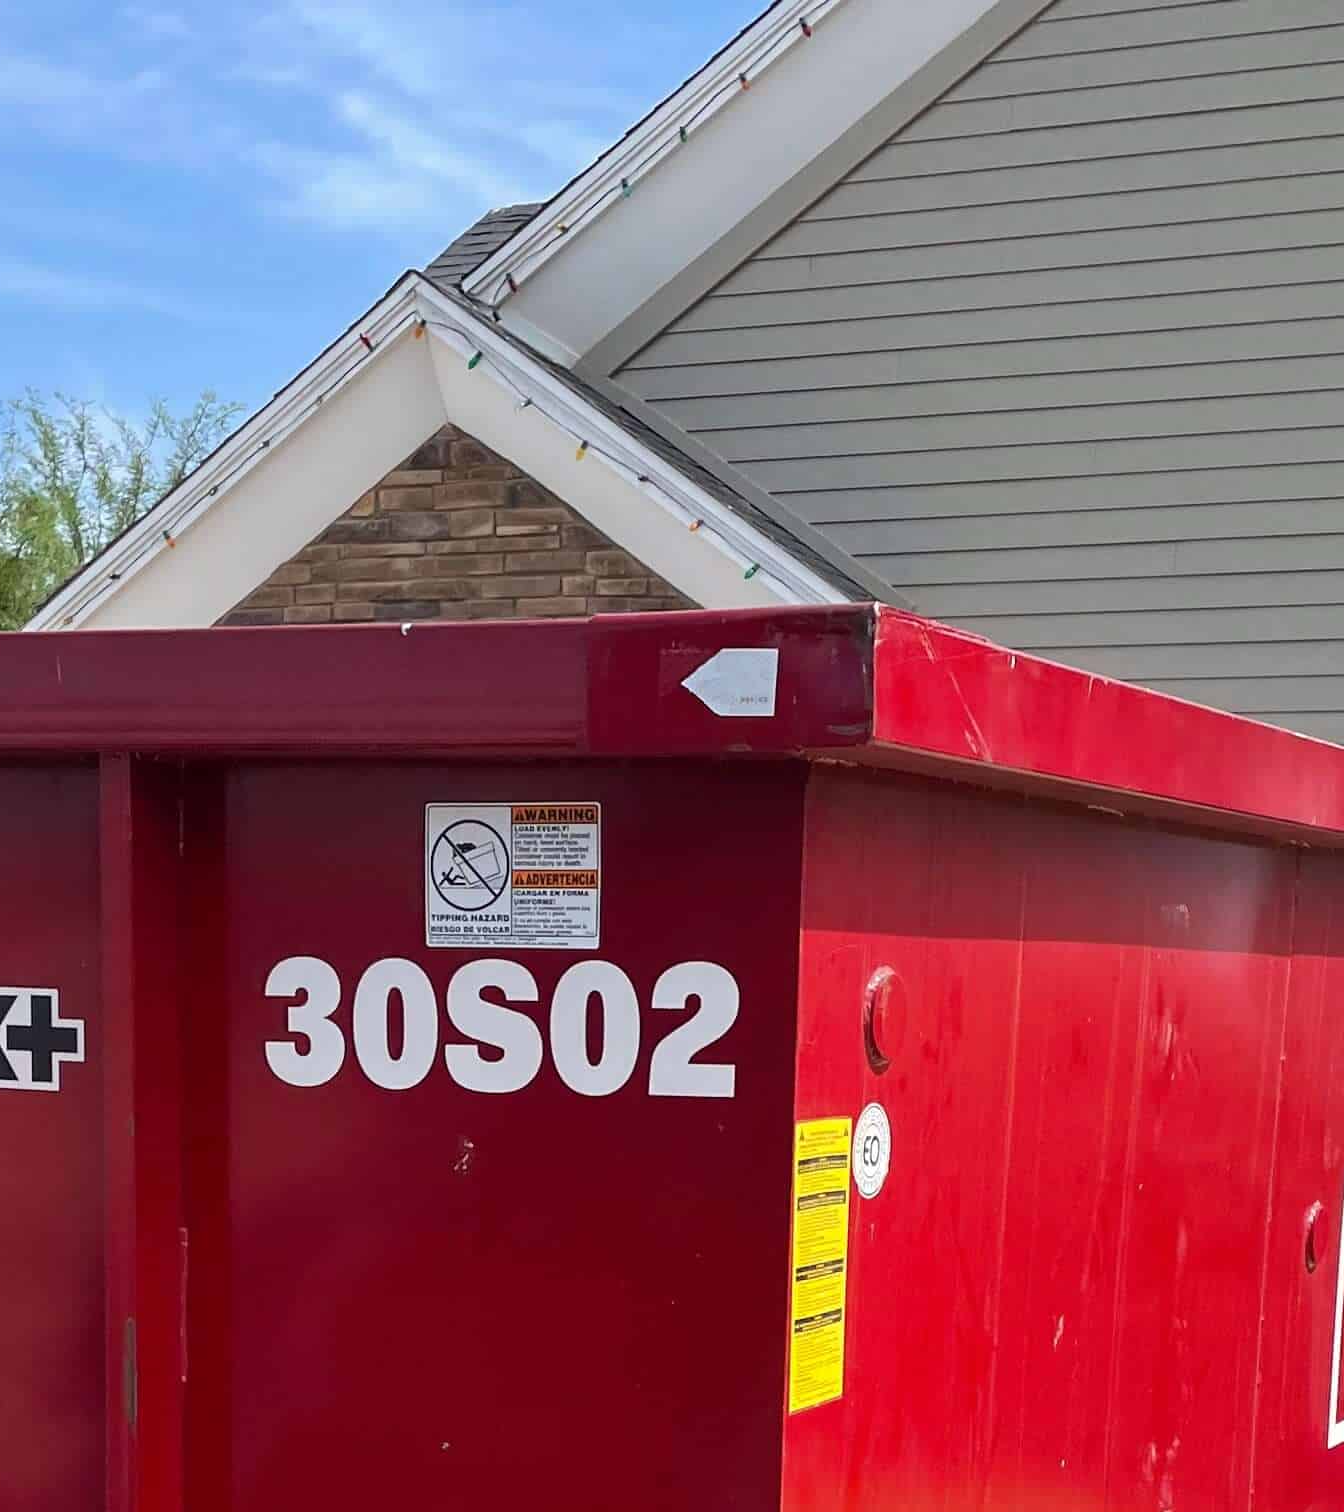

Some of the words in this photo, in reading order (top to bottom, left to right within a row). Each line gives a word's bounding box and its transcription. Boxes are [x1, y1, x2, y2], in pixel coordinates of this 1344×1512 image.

[525, 808, 595, 822] WARNING
[527, 873, 596, 886] ADVERTENCIA
[431, 914, 468, 922] TIPPING
[470, 914, 510, 922] HAZARD
[264, 956, 740, 1099] 30S02
